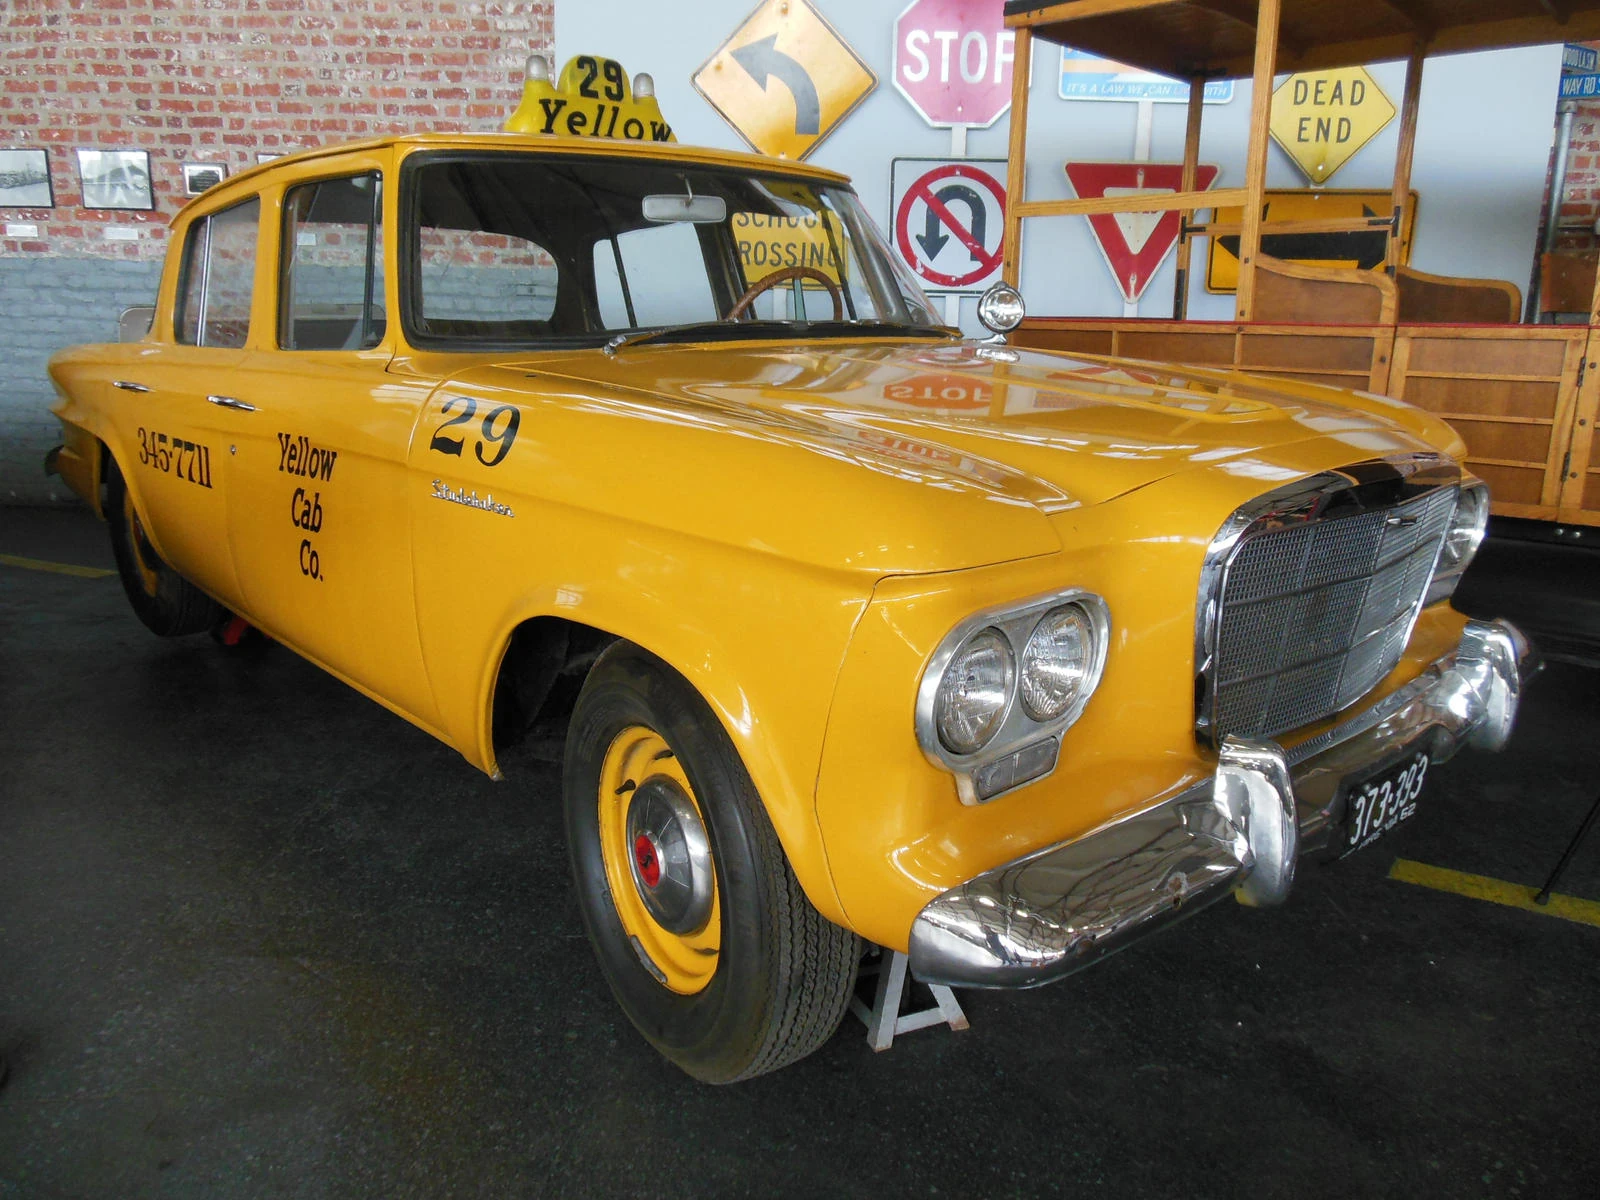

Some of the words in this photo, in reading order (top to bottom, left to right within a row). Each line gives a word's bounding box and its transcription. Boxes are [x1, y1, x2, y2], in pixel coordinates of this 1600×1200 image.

[902, 29, 1016, 84] STOP
[577, 56, 624, 102] 29
[1066, 84, 1088, 93] IT'S
[1090, 84, 1097, 93] A
[1101, 84, 1124, 94] LAW
[1128, 85, 1146, 94] WE
[1148, 85, 1170, 95] CAN
[1293, 79, 1366, 106] DEAD
[1563, 78, 1583, 95] WAY
[1584, 76, 1596, 95] RD
[539, 98, 672, 142] Yellow
[1297, 117, 1352, 143] END
[738, 240, 837, 267] ROSSIN
[430, 397, 520, 467] 29
[278, 432, 338, 482] Yellow
[291, 487, 323, 533] Cab
[431, 478, 515, 518] Studebaker
[299, 539, 324, 582] Co.
